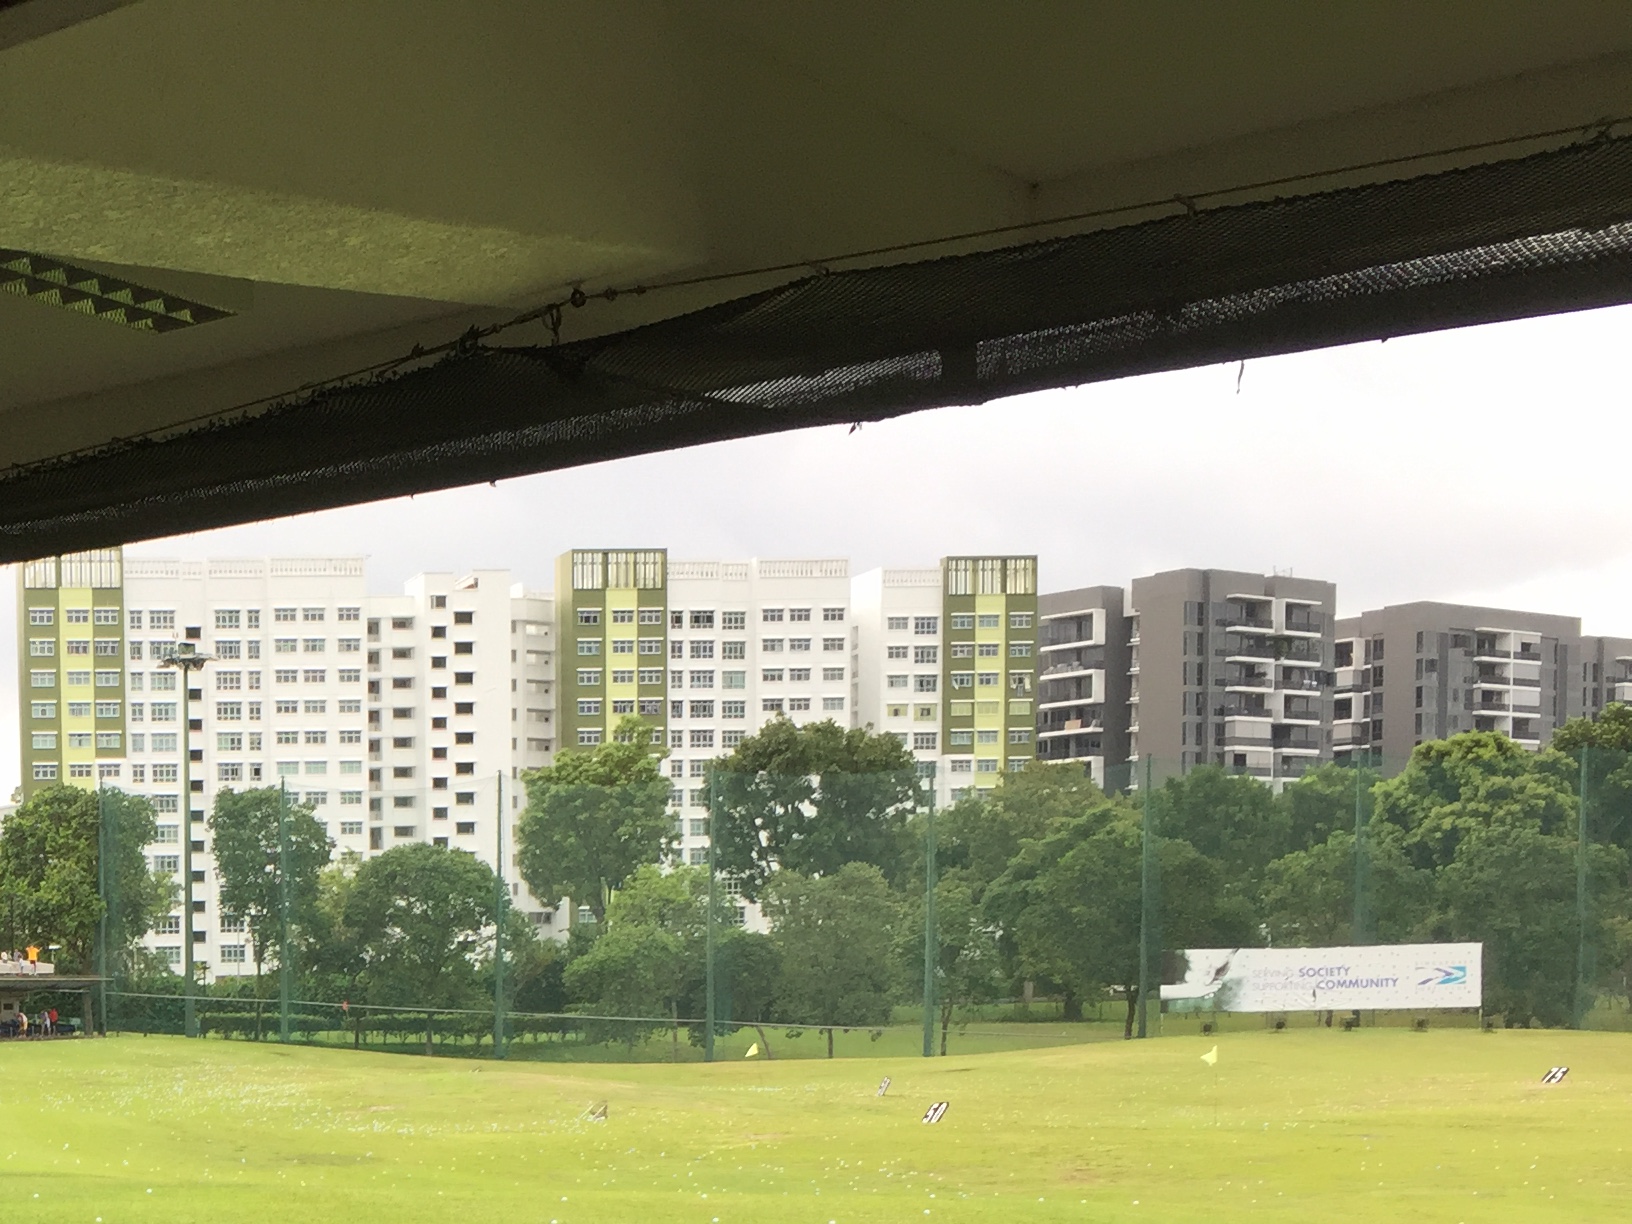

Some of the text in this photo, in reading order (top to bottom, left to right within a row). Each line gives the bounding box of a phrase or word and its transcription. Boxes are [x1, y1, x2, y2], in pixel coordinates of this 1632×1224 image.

[1298, 965, 1352, 978] SOCIETY
[1316, 978, 1399, 991] COMMUNITY
[1542, 1067, 1568, 1083] 75
